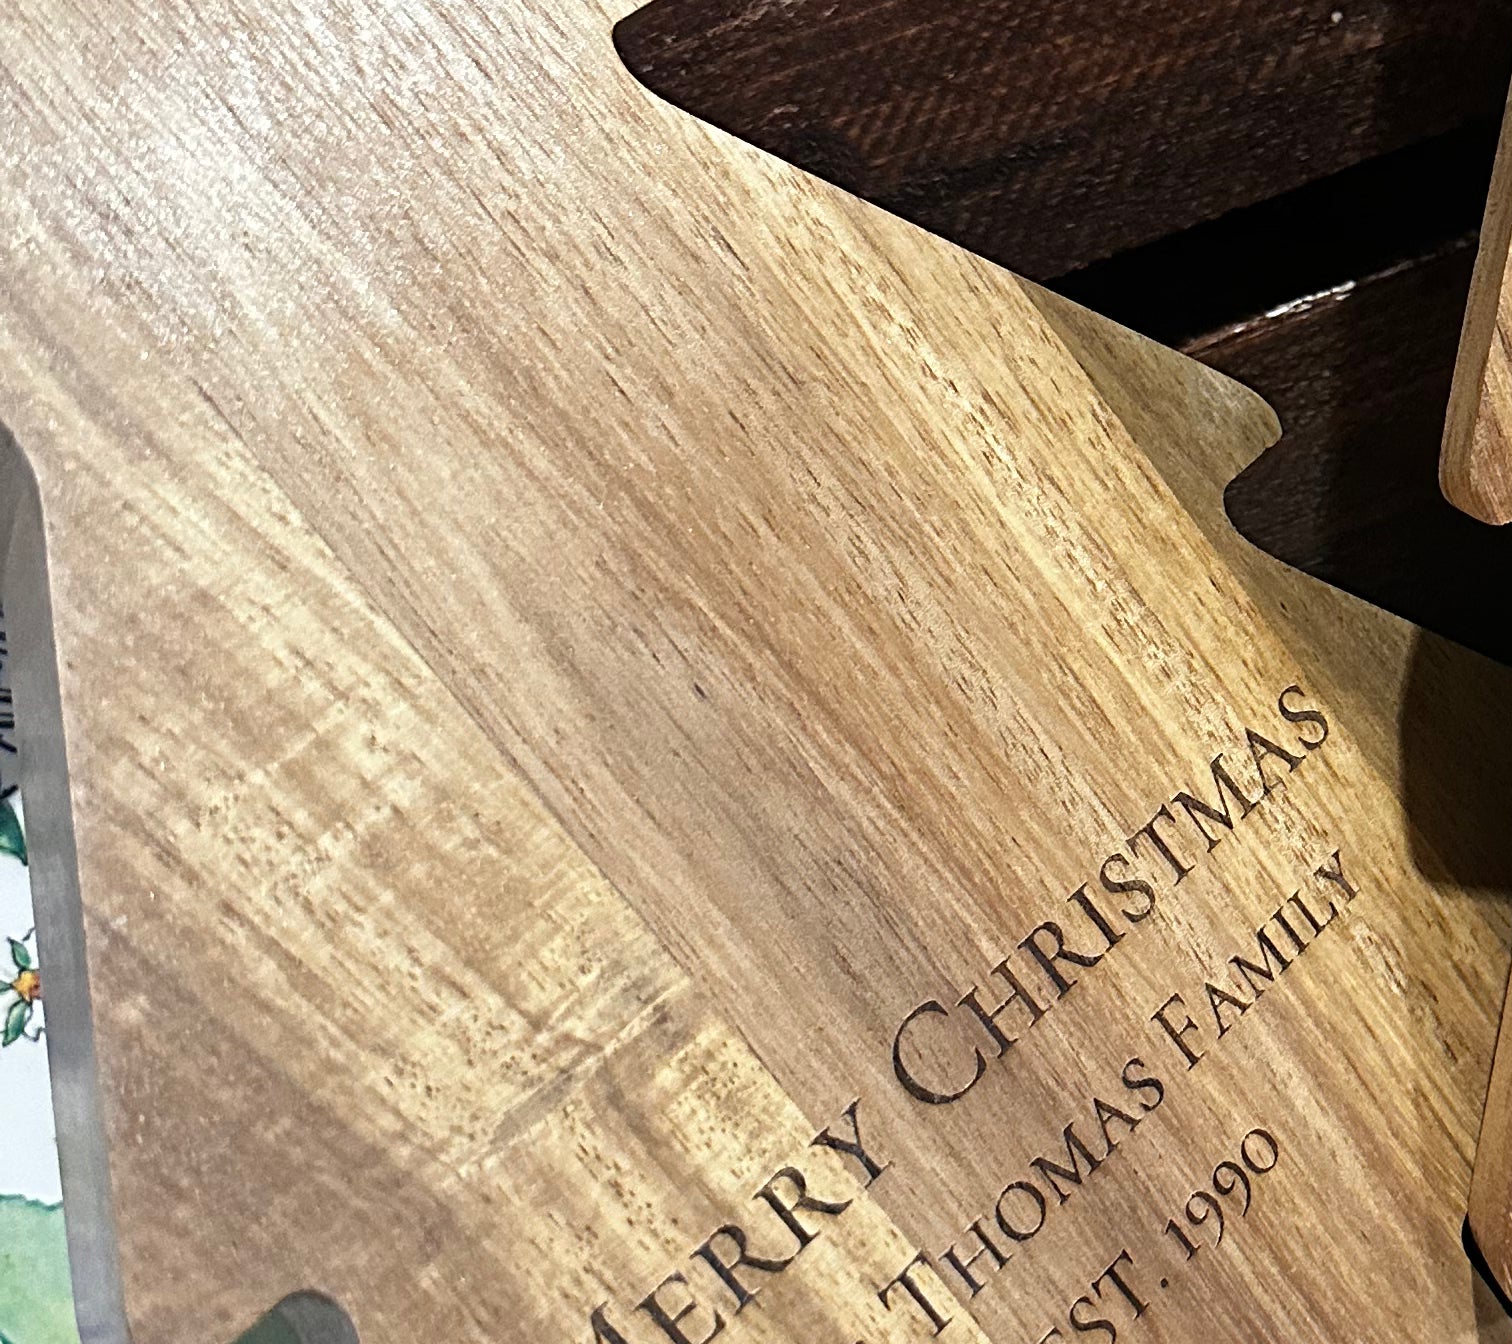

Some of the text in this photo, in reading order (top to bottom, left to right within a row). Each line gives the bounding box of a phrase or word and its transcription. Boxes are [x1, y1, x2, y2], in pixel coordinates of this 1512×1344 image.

[876, 1056, 1166, 1339] THOMAS
[1150, 848, 1361, 1073] FAMILY
[891, 683, 1331, 1106] CHRISTMAS
[1163, 1126, 1281, 1262] 1990
